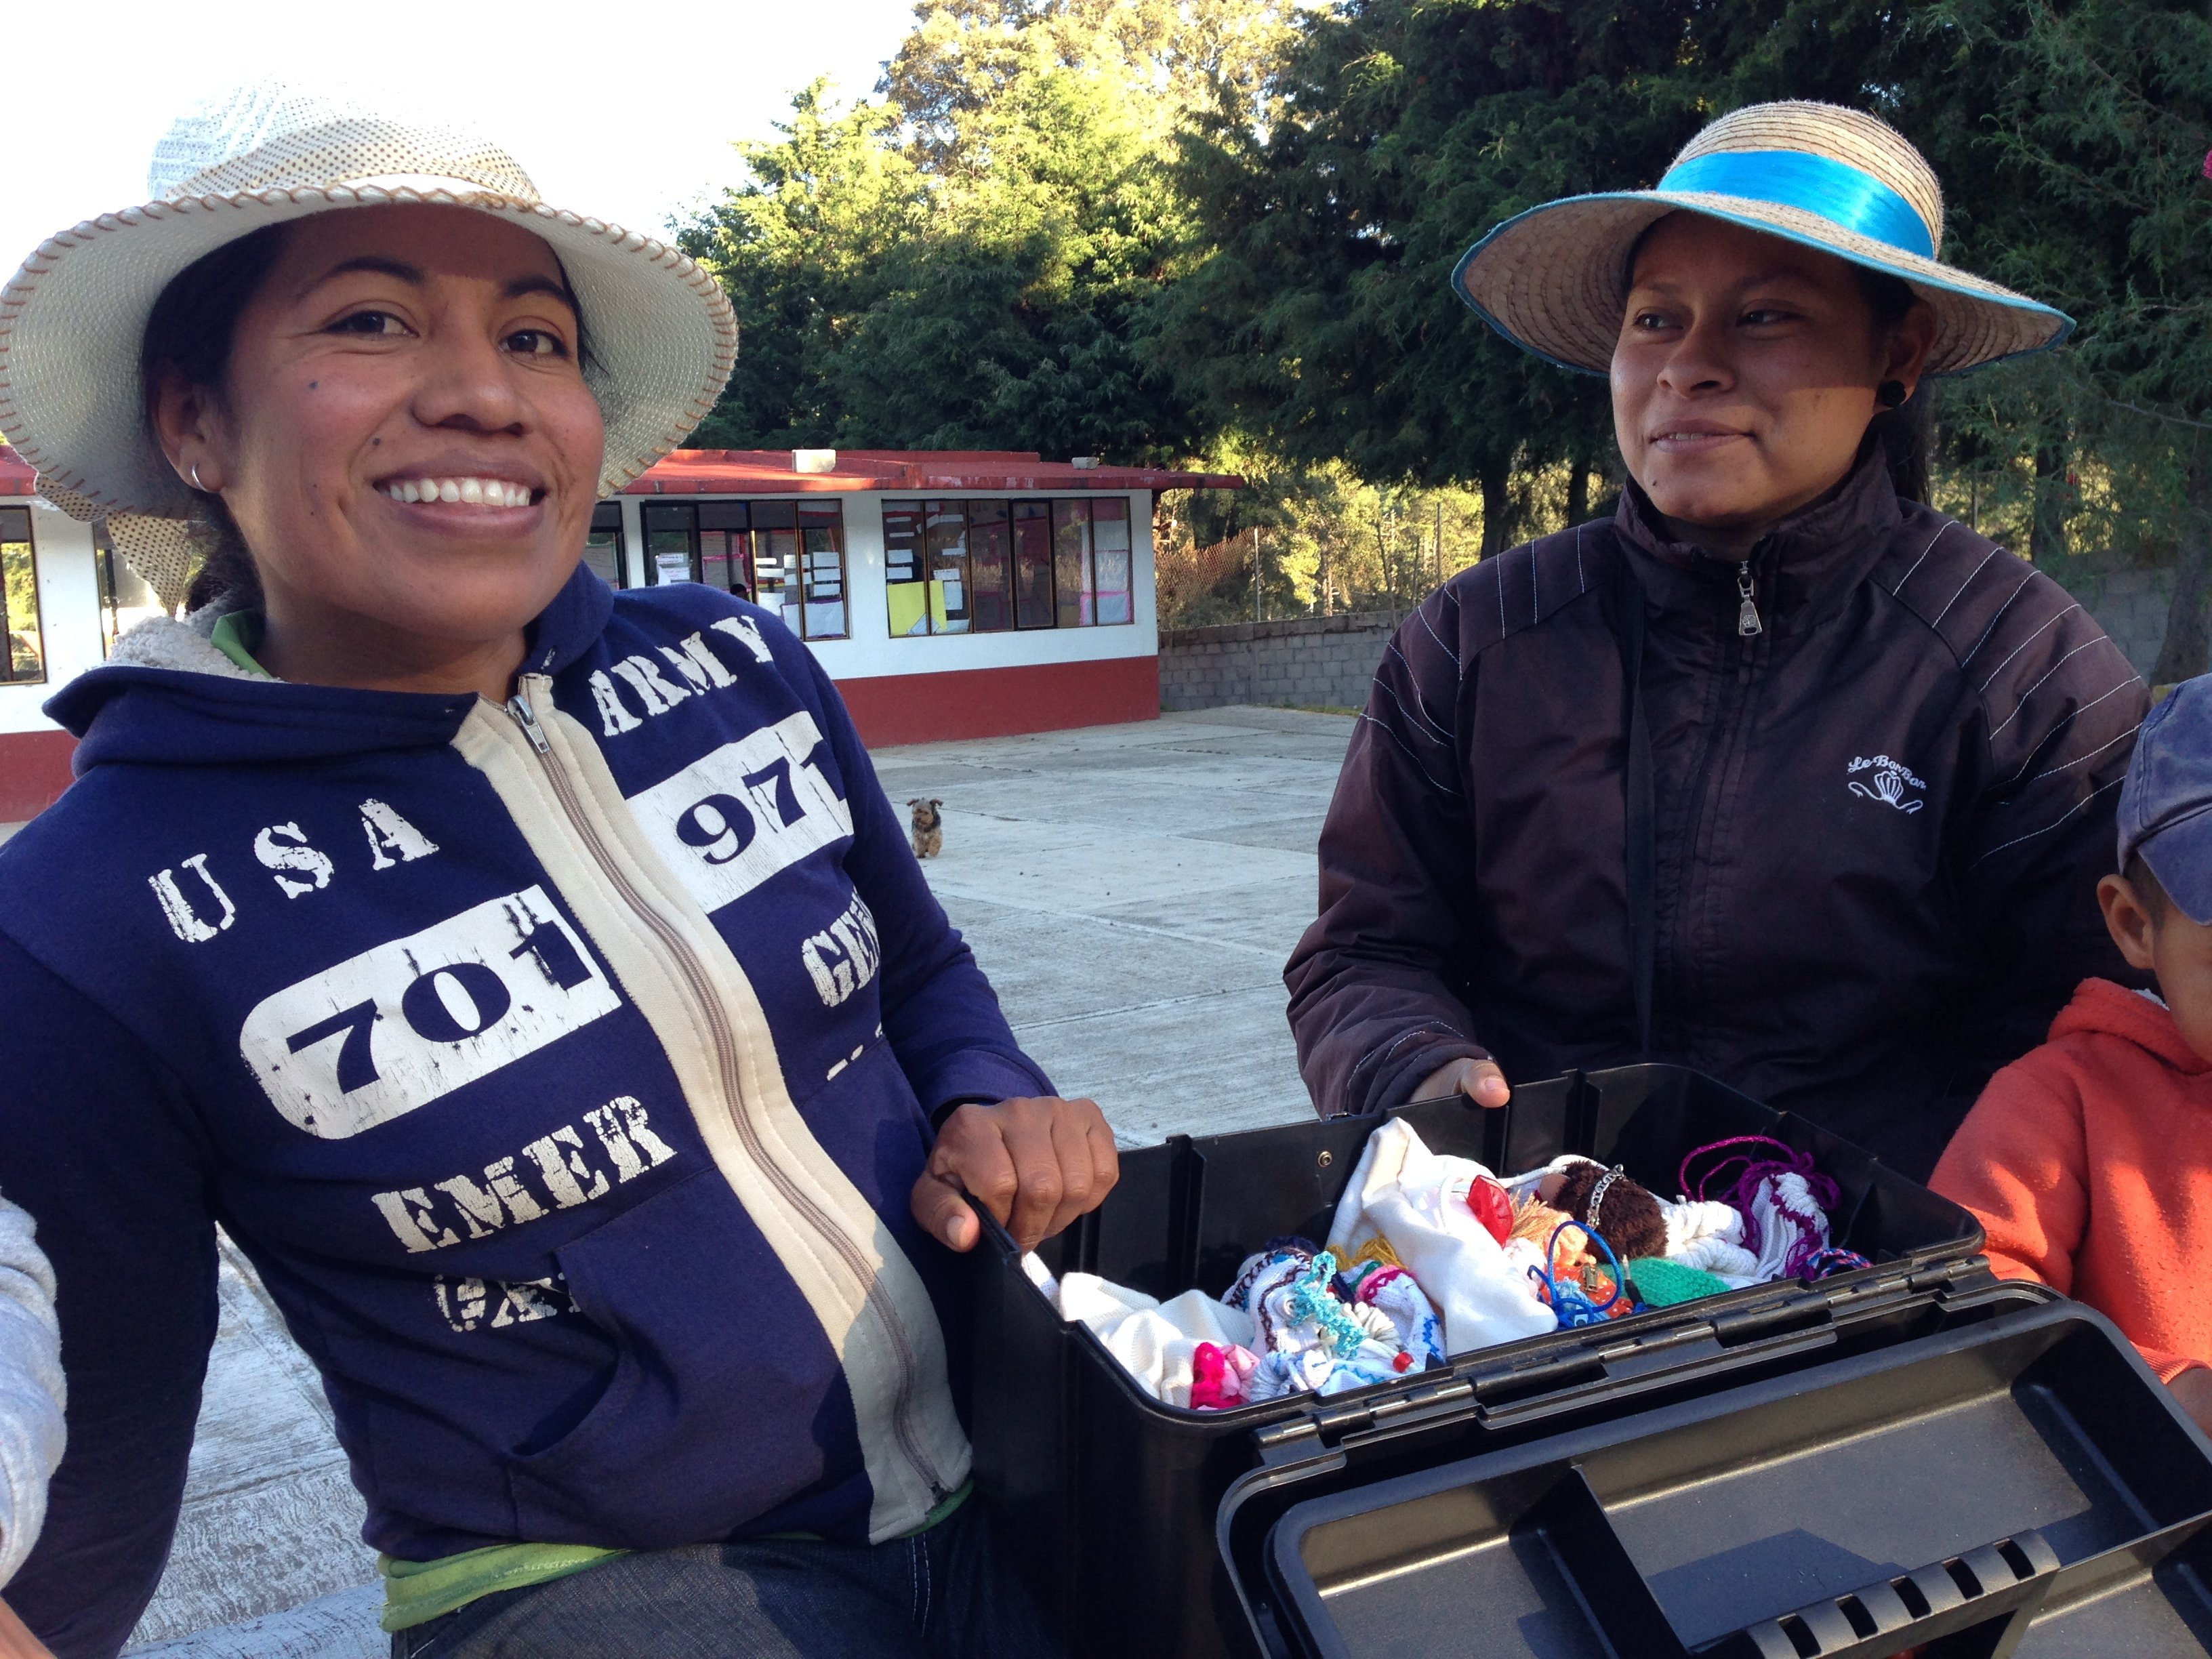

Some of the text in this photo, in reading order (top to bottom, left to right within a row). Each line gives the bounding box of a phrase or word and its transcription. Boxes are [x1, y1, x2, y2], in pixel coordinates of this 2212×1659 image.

[588, 615, 773, 737] ARMY
[1847, 756, 1873, 773] Le
[285, 920, 594, 1096] 701
[370, 1095, 678, 1254] EMER
